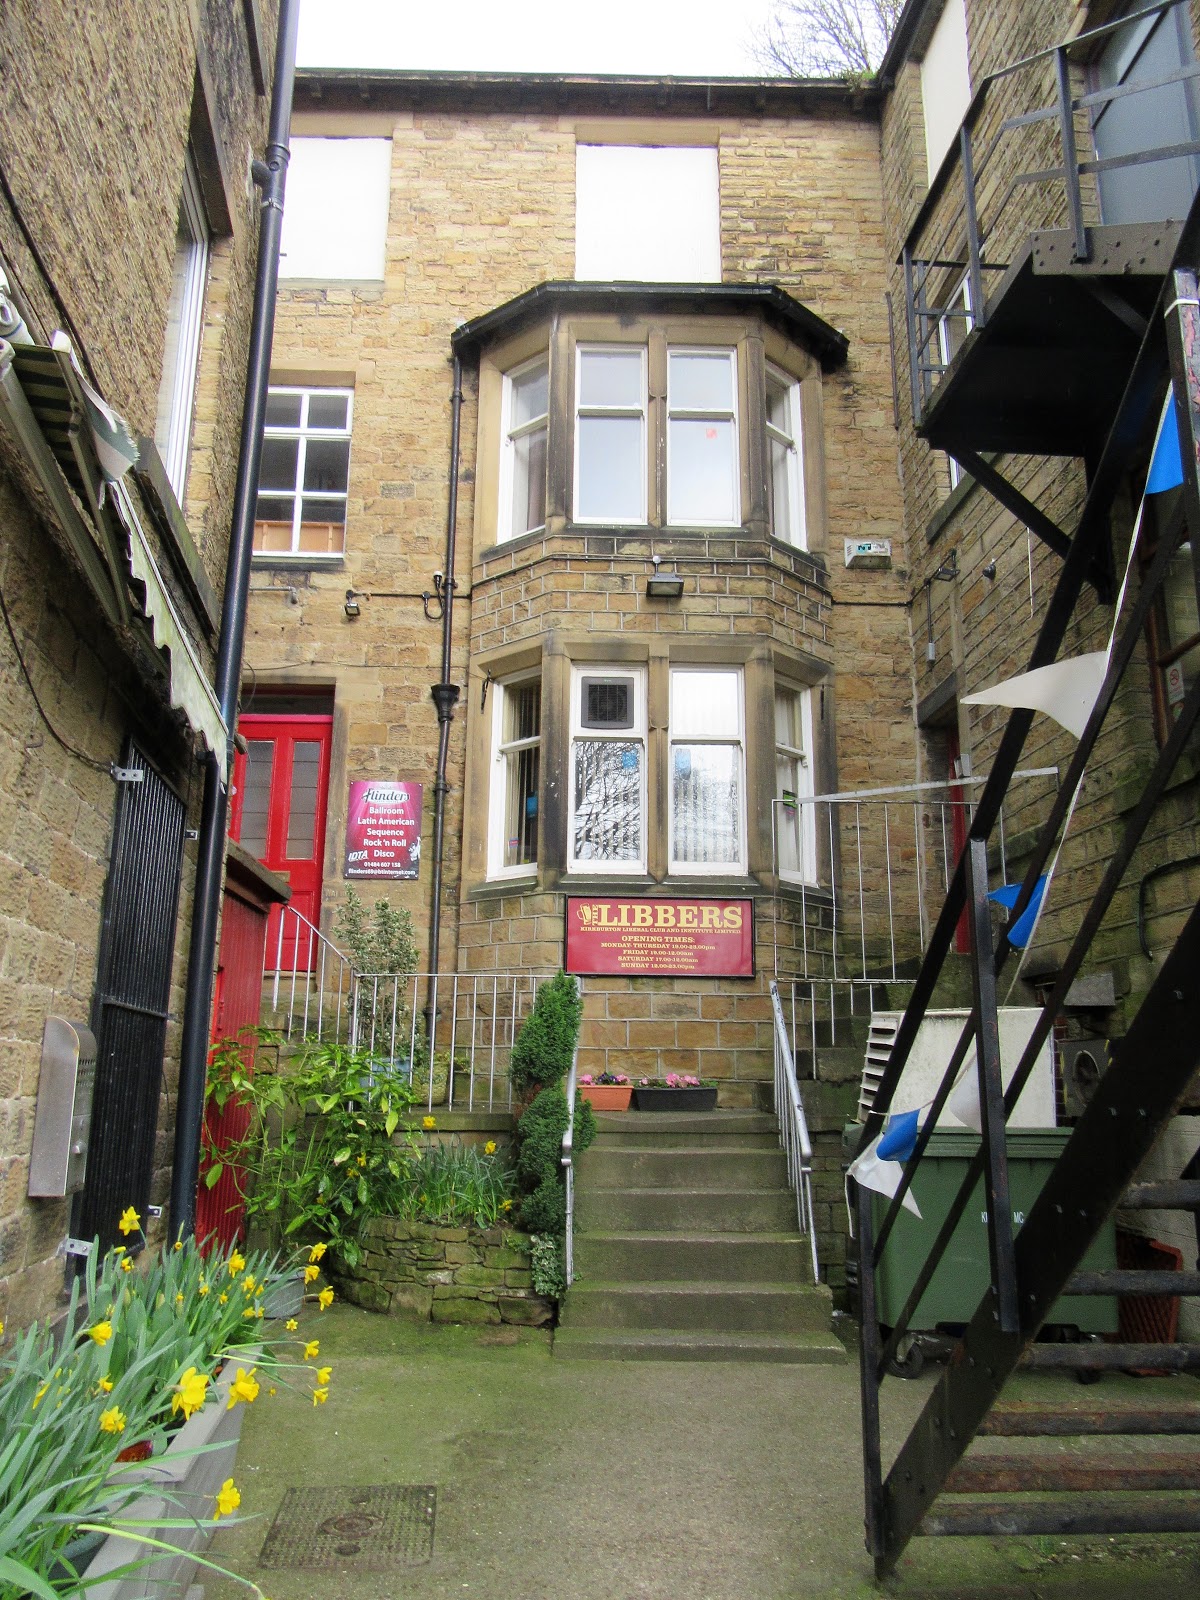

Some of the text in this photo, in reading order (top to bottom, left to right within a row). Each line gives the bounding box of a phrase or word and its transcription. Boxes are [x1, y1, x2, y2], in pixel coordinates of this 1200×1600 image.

[369, 807, 404, 815] Ballroom
[357, 817, 415, 826] Latin American
[367, 828, 404, 837] Sequence
[363, 838, 382, 847] Rock
[391, 839, 407, 847] Roll
[348, 850, 369, 862] IDTA
[373, 850, 395, 858] Disco
[598, 904, 742, 929] LIBBERS
